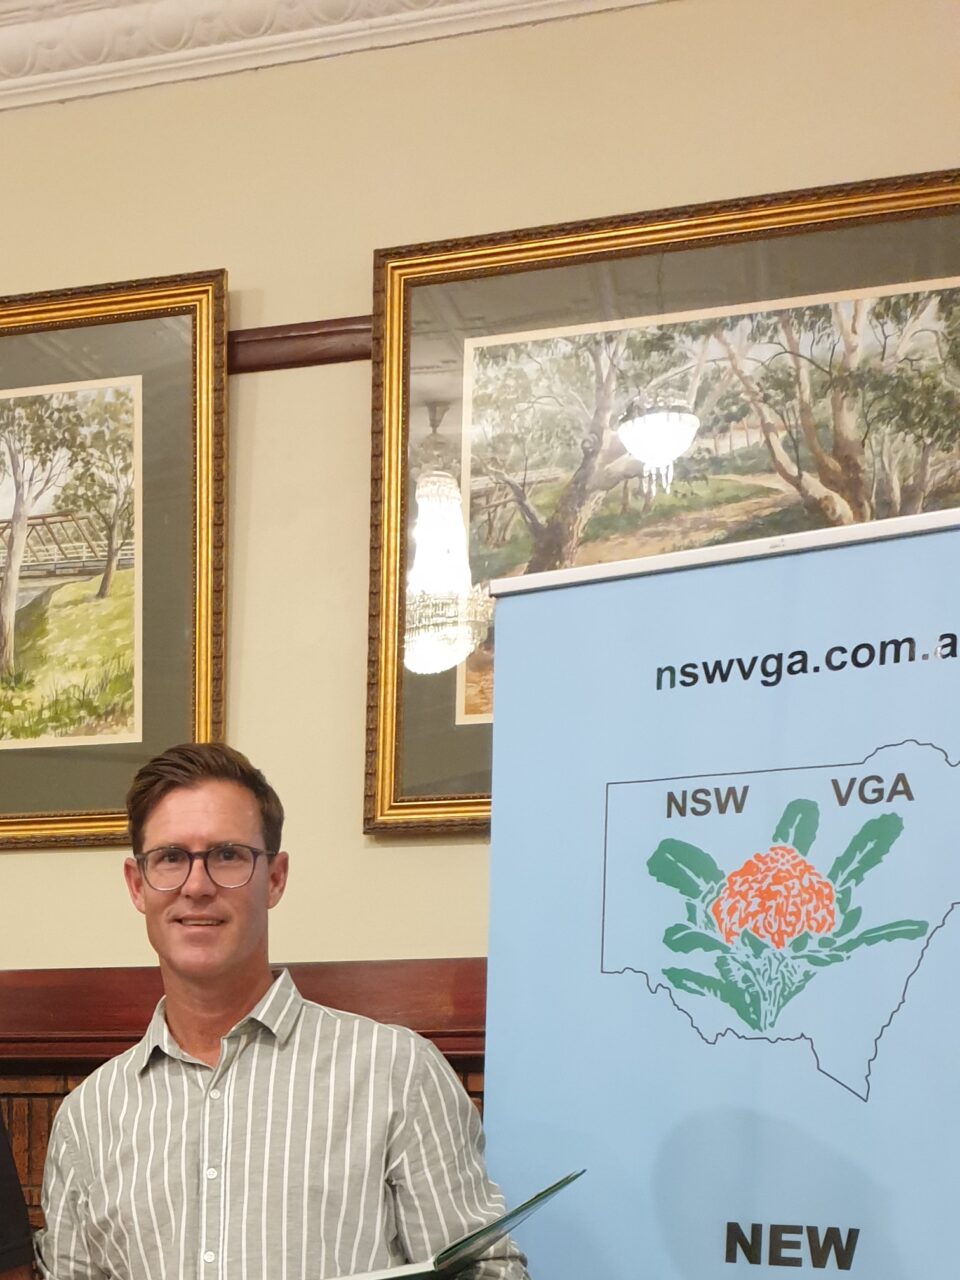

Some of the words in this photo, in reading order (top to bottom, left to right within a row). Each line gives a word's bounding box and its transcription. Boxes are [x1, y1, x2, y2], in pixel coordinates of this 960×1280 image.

[666, 785, 750, 818] NSW
[831, 772, 915, 806] VGA
[725, 1221, 860, 1271] NEW
